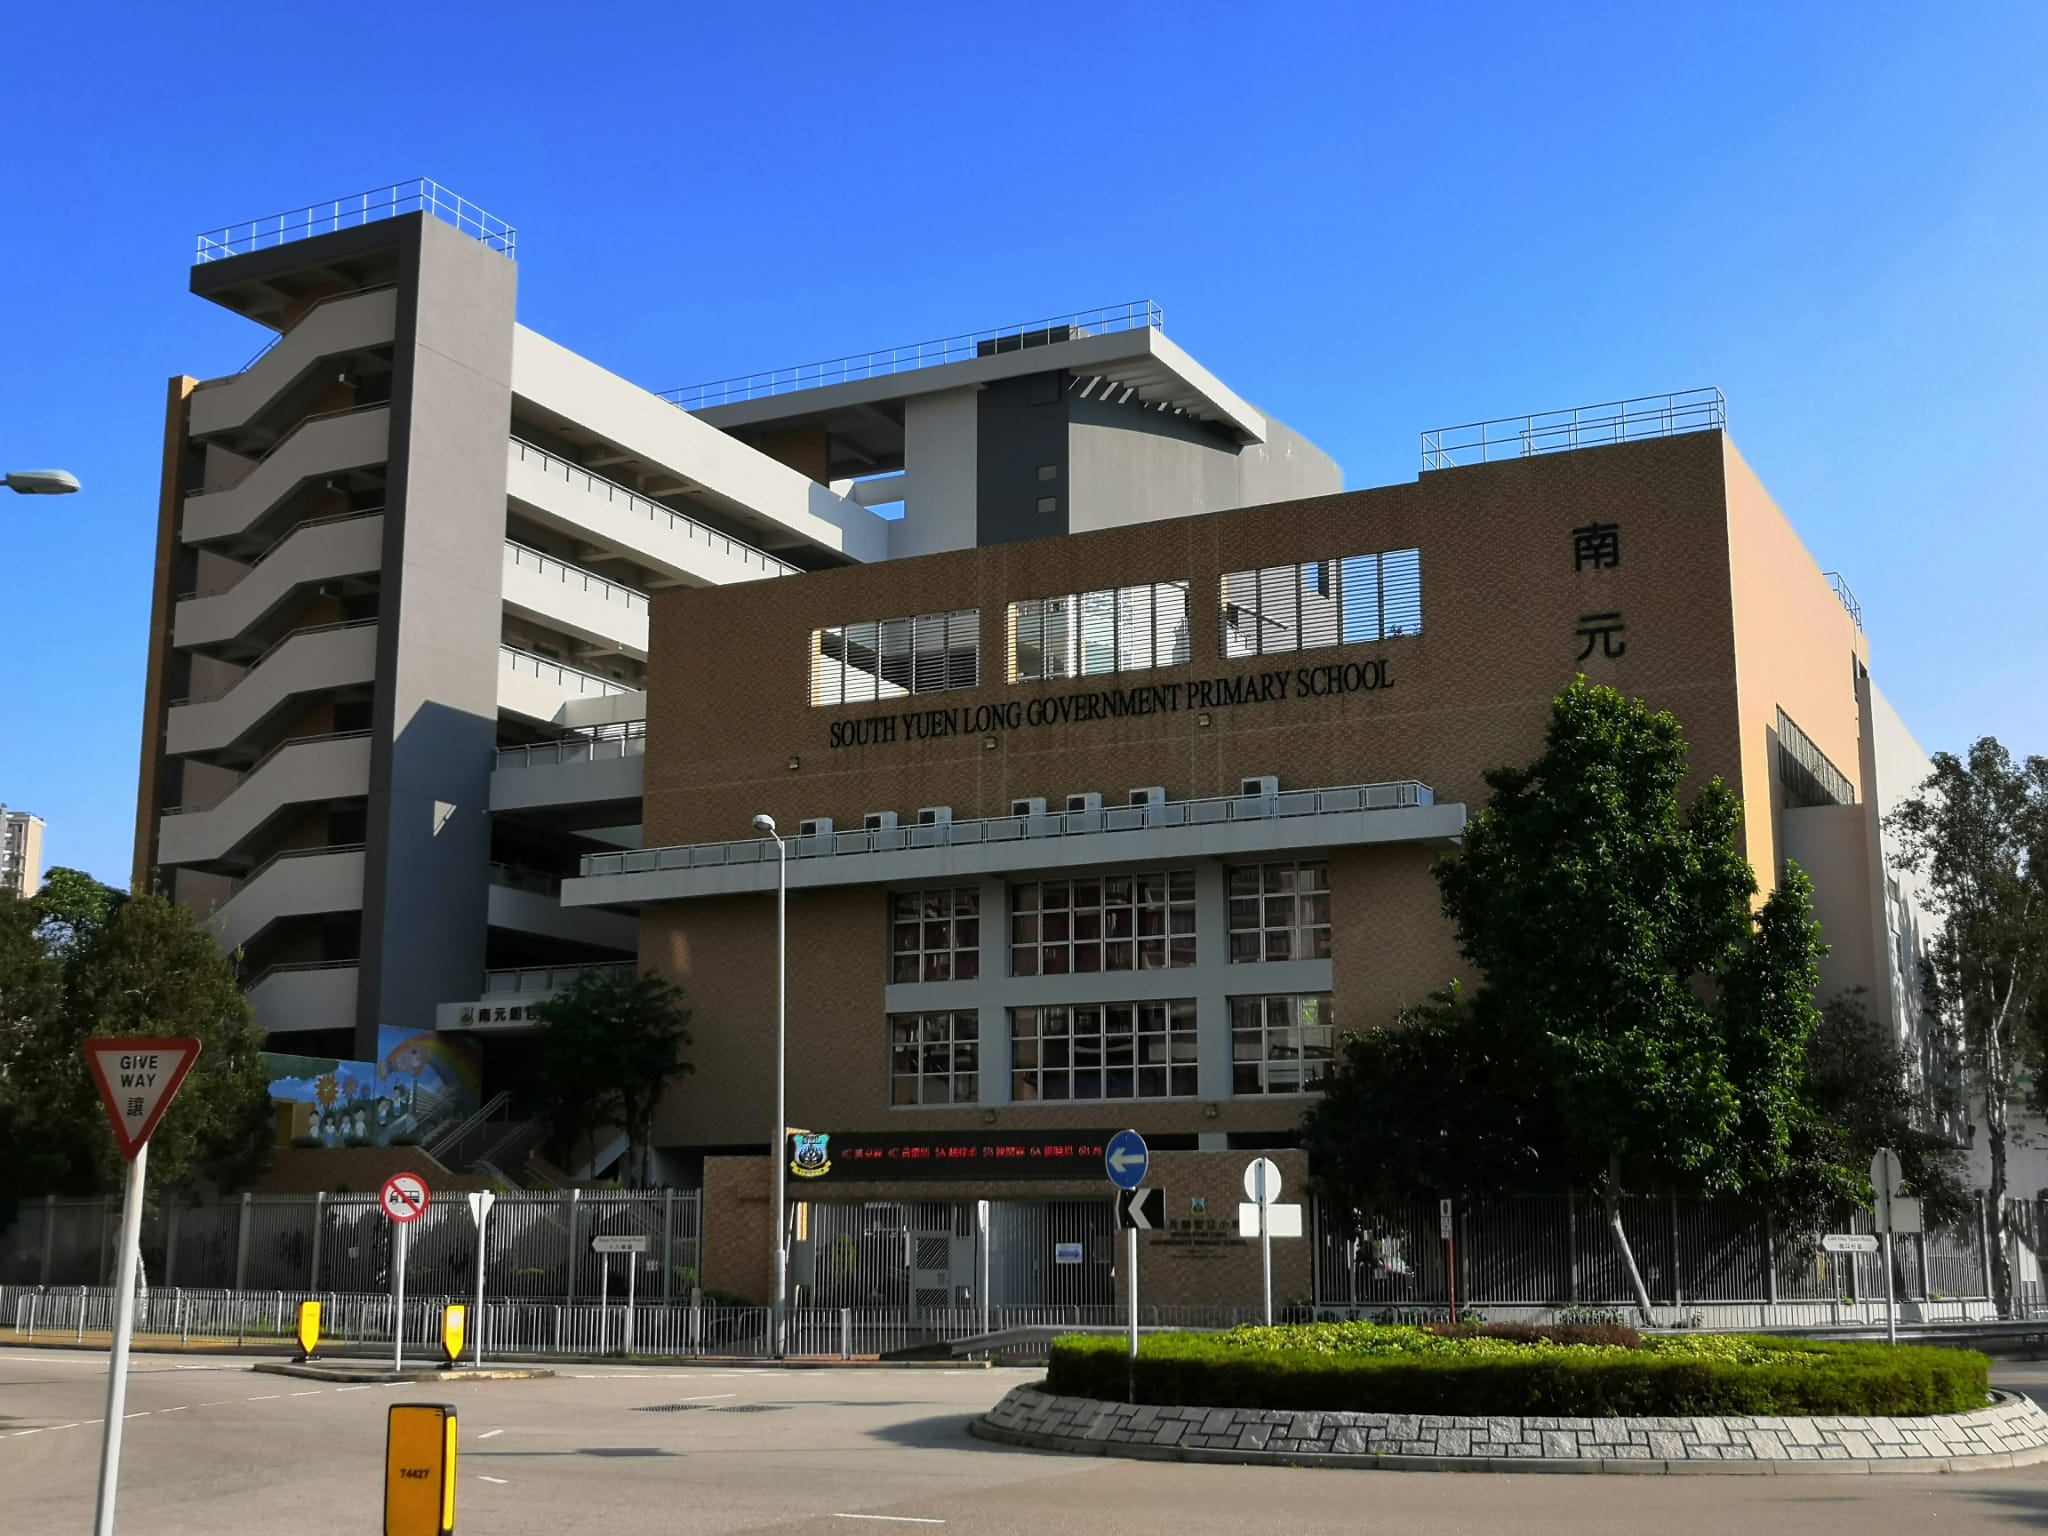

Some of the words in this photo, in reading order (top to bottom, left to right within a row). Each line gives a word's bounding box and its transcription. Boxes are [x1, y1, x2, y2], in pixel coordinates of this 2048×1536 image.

[1572, 522, 1626, 662] 南元
[830, 716, 897, 749] SOUTH
[902, 709, 957, 741] YUEN
[963, 701, 1021, 735] LONG
[1027, 683, 1181, 727] GOVERNMENT
[1186, 671, 1291, 710] PRIMARY
[1297, 659, 1395, 698] SCHOOL
[120, 1055, 158, 1070] GIVE
[120, 1074, 156, 1088] WAY
[400, 1468, 430, 1480] 74427
